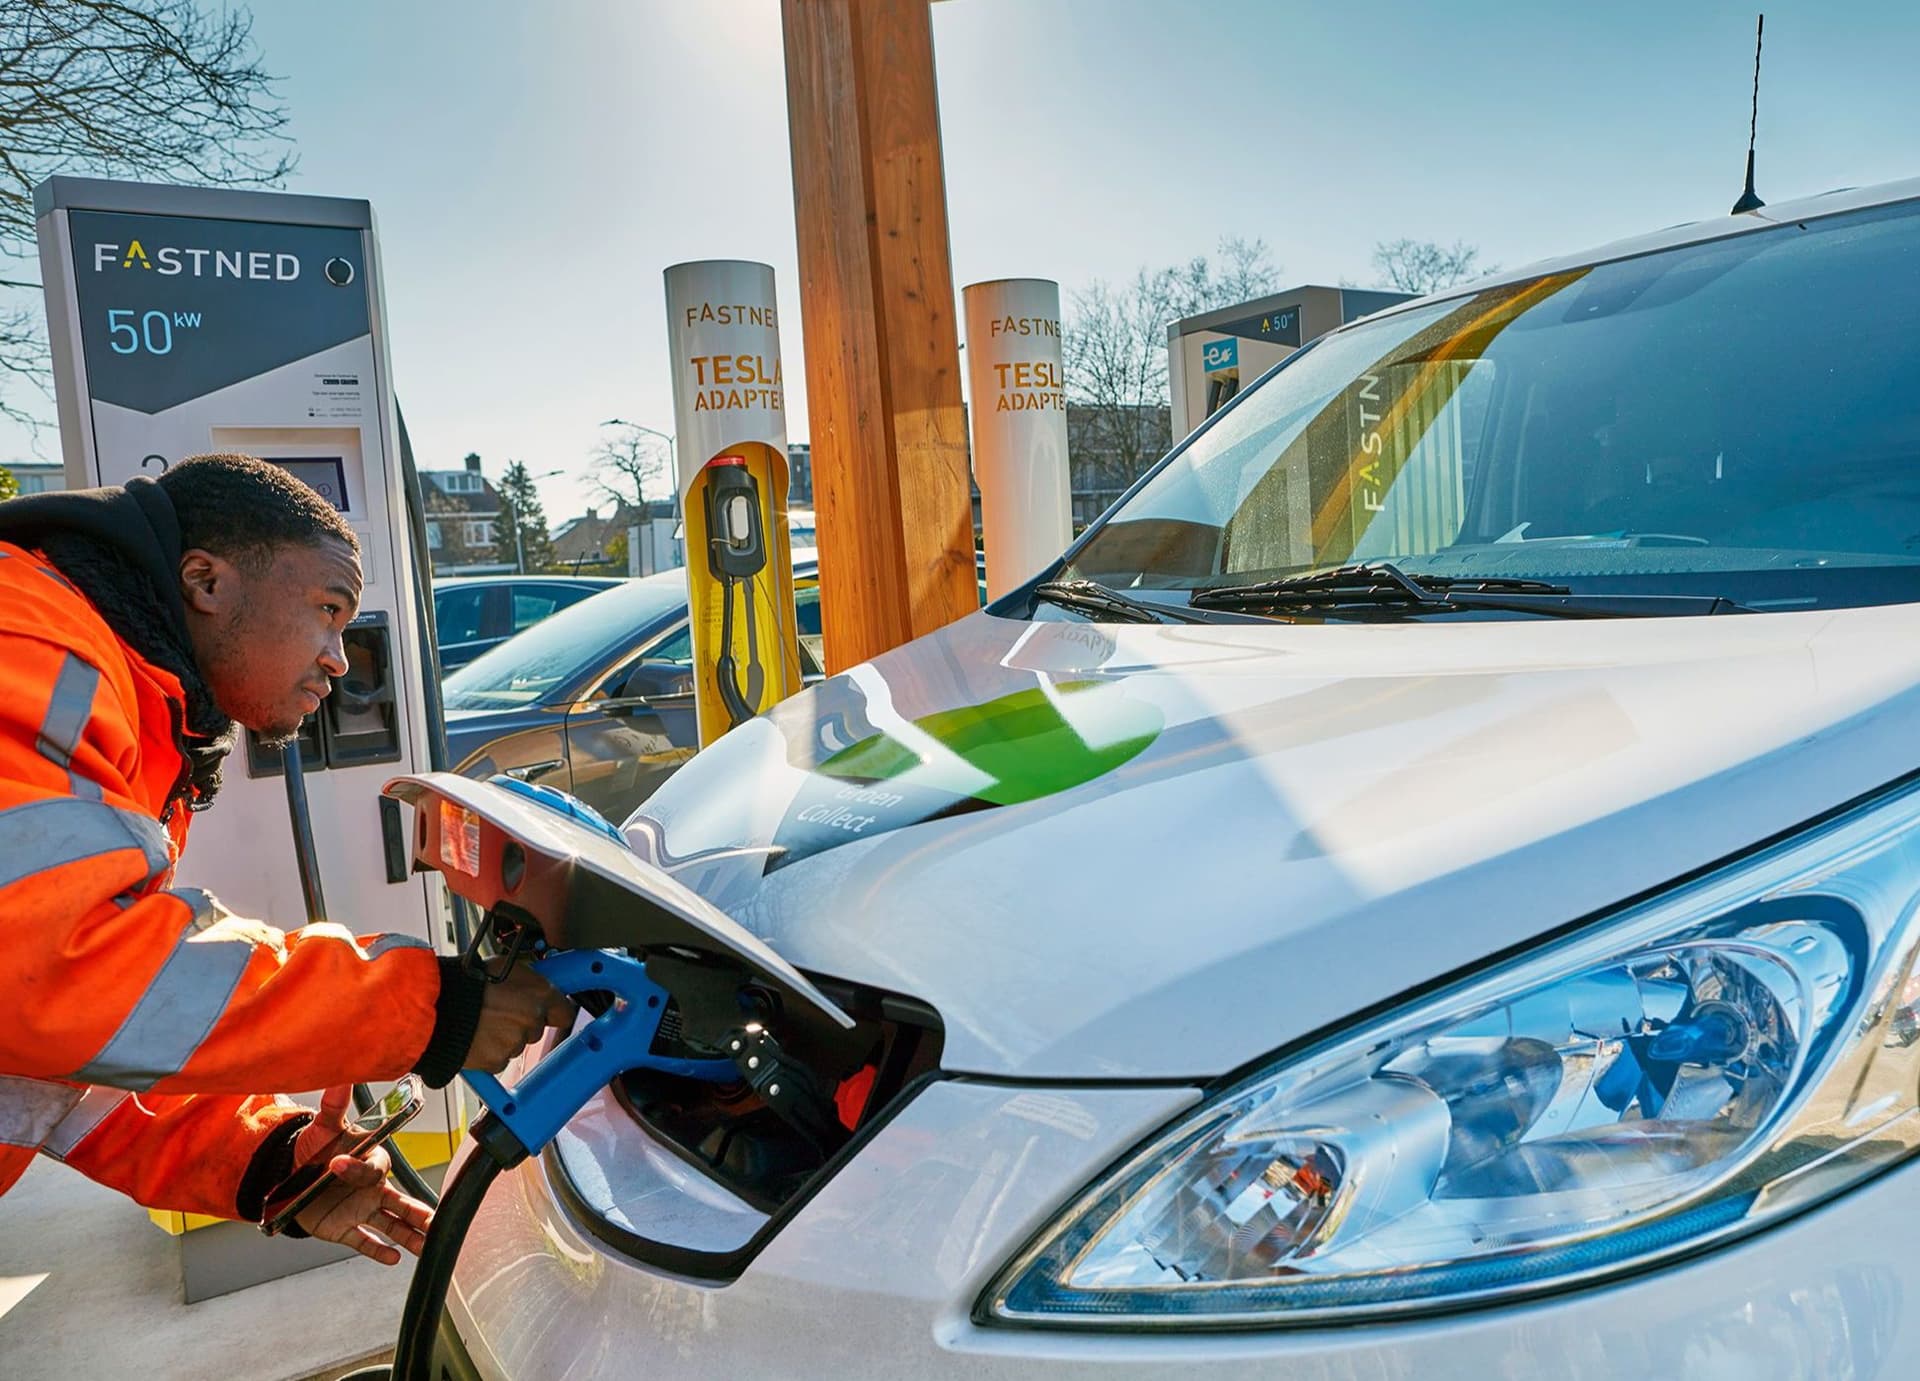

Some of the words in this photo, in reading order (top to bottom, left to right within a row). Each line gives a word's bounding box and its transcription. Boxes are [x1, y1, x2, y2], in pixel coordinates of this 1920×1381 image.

[94, 239, 300, 281] FASTNED
[993, 361, 1064, 390] TESL
[694, 388, 783, 412] ADAPTE
[797, 803, 877, 833] Collect
